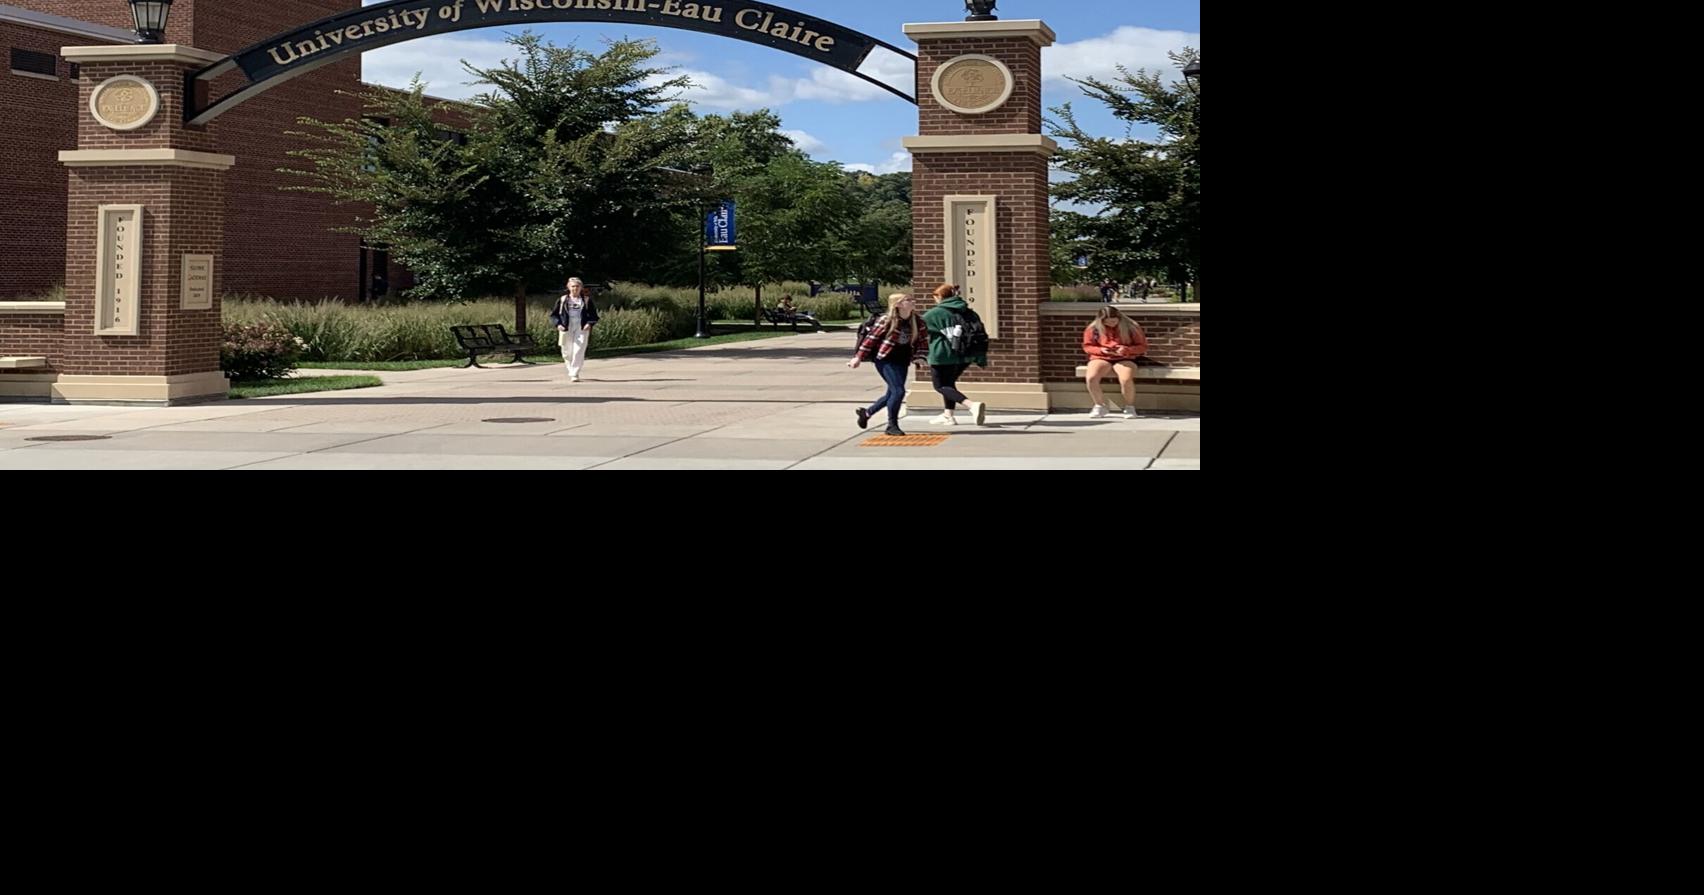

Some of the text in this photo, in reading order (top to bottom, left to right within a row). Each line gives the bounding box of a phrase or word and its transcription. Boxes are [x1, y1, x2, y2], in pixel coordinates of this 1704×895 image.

[267, 7, 431, 66] University
[438, 0, 463, 22] of
[734, 8, 835, 52] Claire
[114, 216, 125, 323] FOUNDED 1916
[966, 208, 976, 277] FOUNDED
